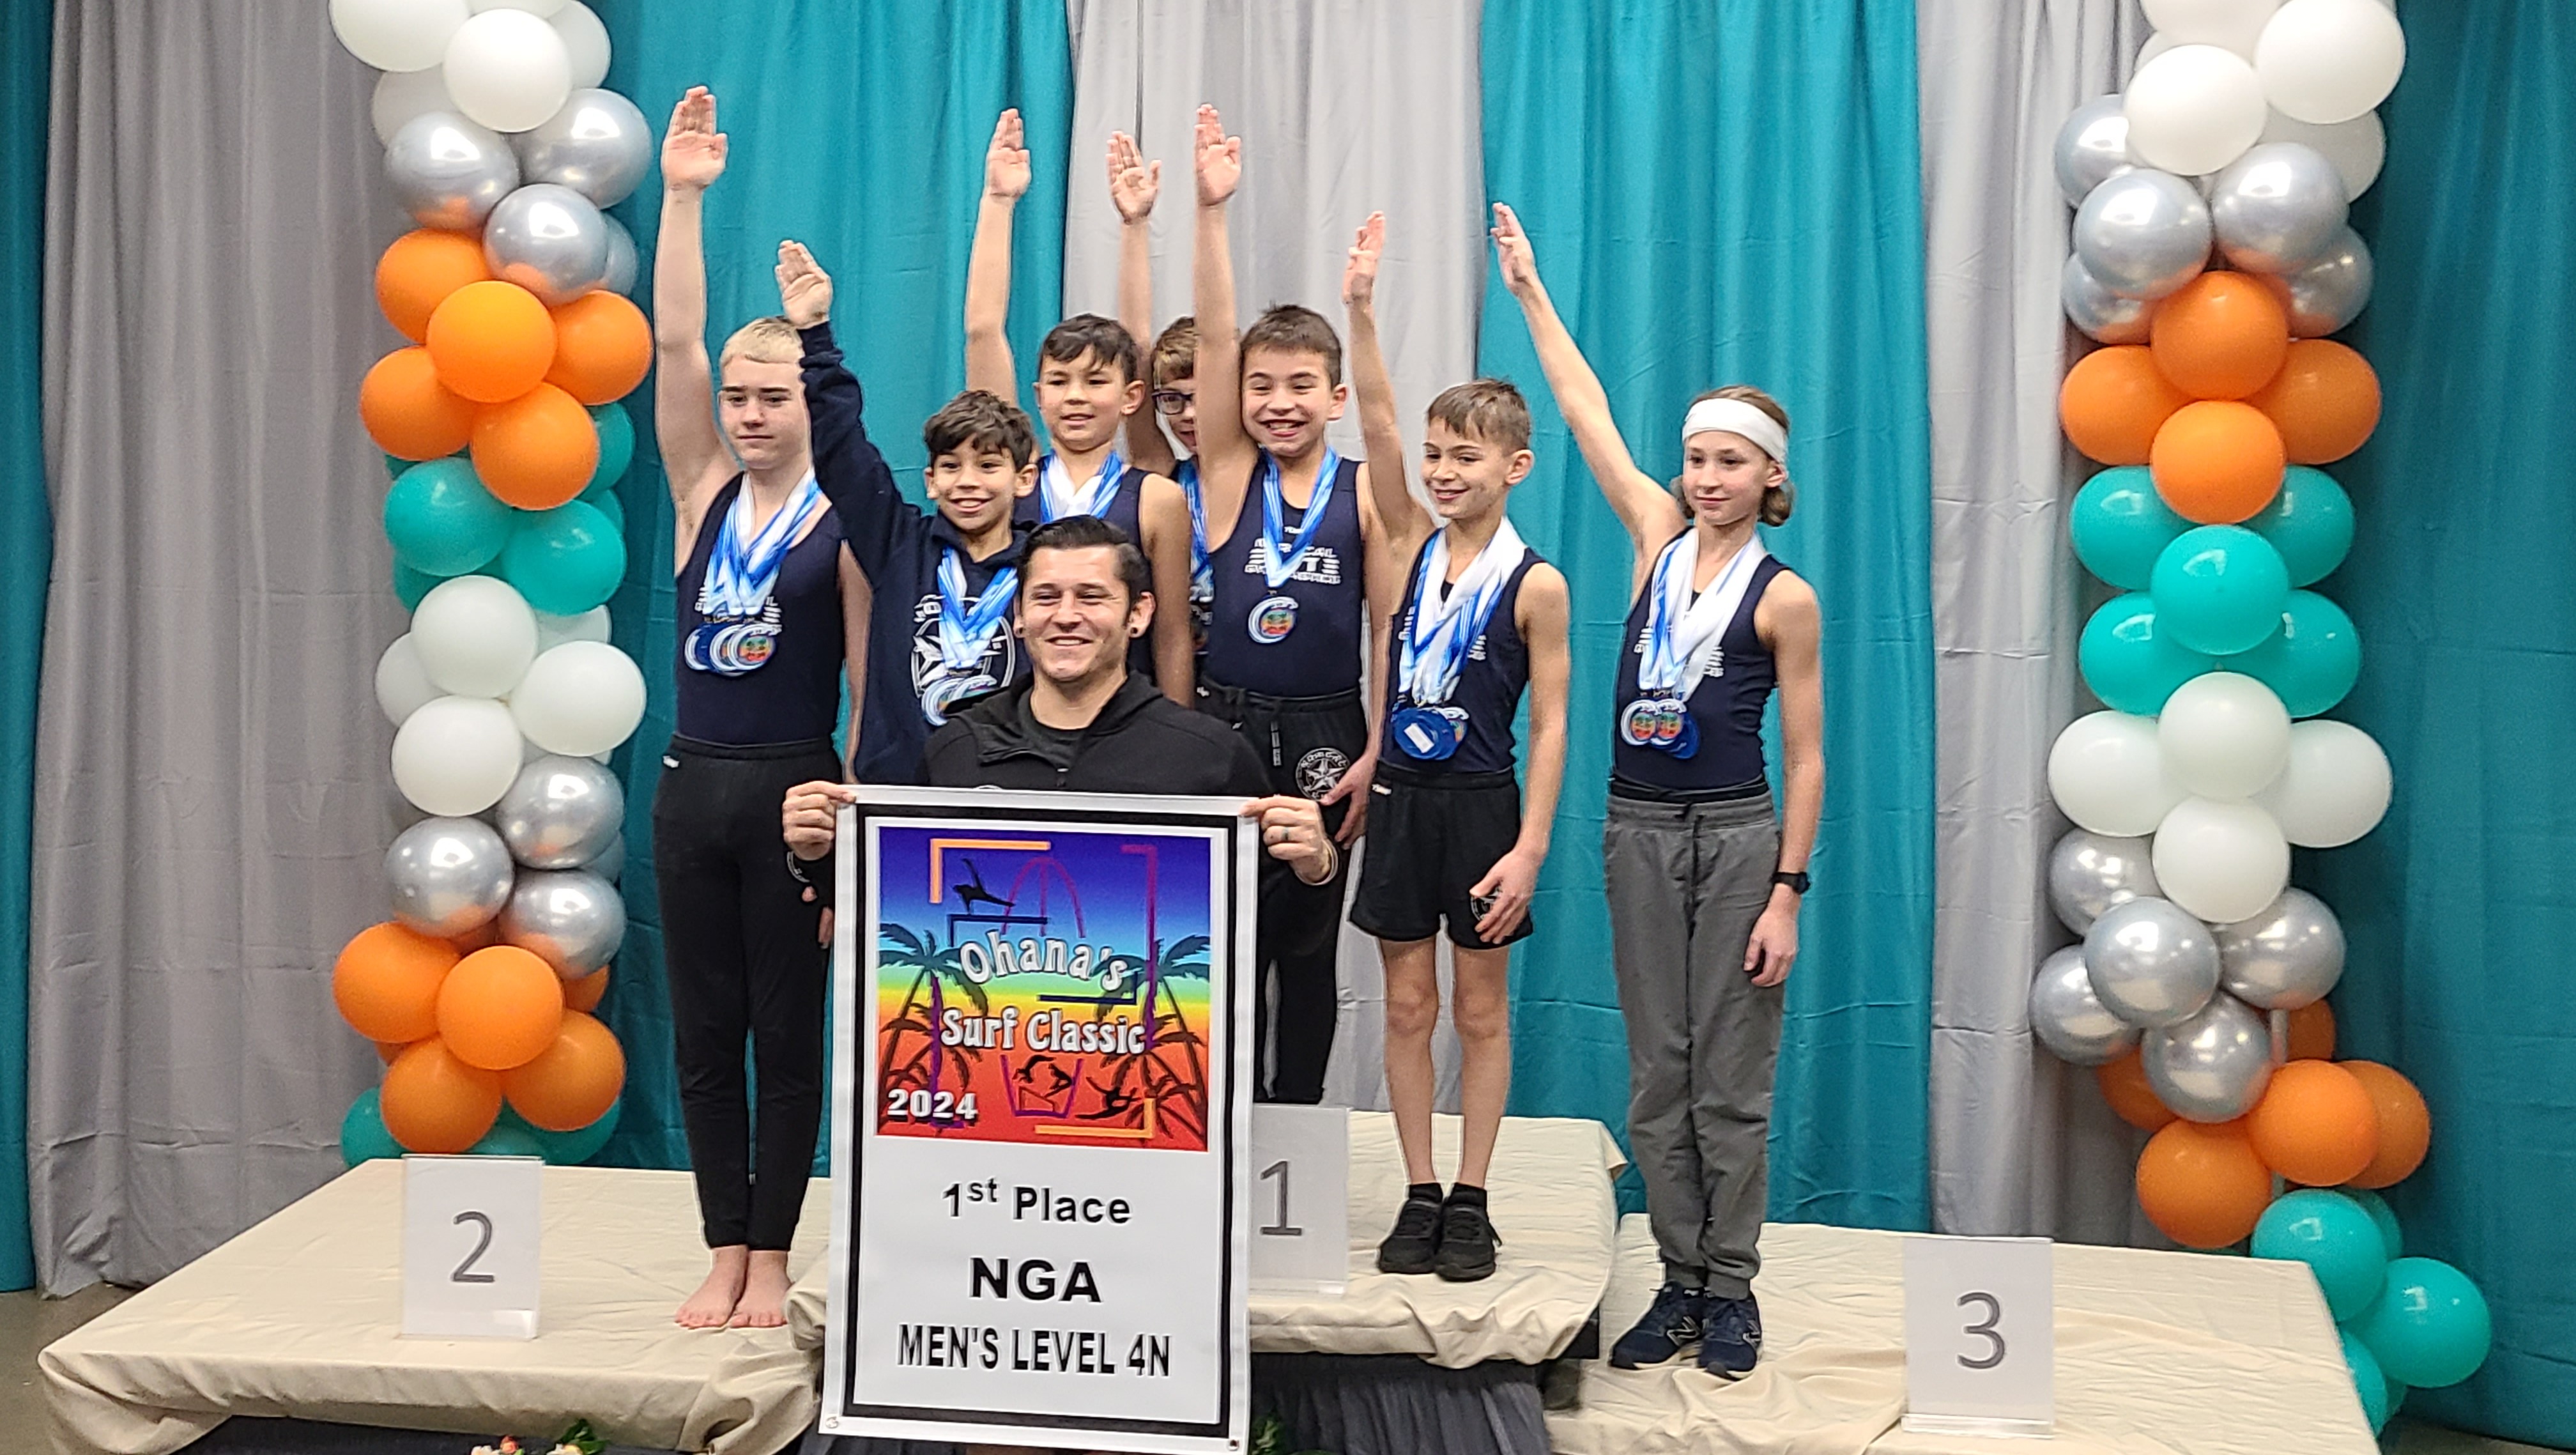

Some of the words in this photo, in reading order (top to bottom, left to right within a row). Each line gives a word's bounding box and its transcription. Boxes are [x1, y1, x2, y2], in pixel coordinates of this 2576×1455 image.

[960, 928, 1128, 991] Ohana's
[940, 1006, 1019, 1049] Surf
[1026, 1008, 1146, 1054] Classic
[887, 1088, 978, 1122] 2024
[942, 1177, 999, 1217] 1st
[1013, 1185, 1131, 1224] Place
[1260, 1160, 1302, 1236] 1
[451, 1211, 495, 1282] 2
[969, 1257, 1103, 1303] NGA
[897, 1323, 1000, 1369] MEN'S
[1011, 1329, 1117, 1374] LEVEL
[1125, 1334, 1171, 1377] 4N
[1957, 1291, 2005, 1369] 3
